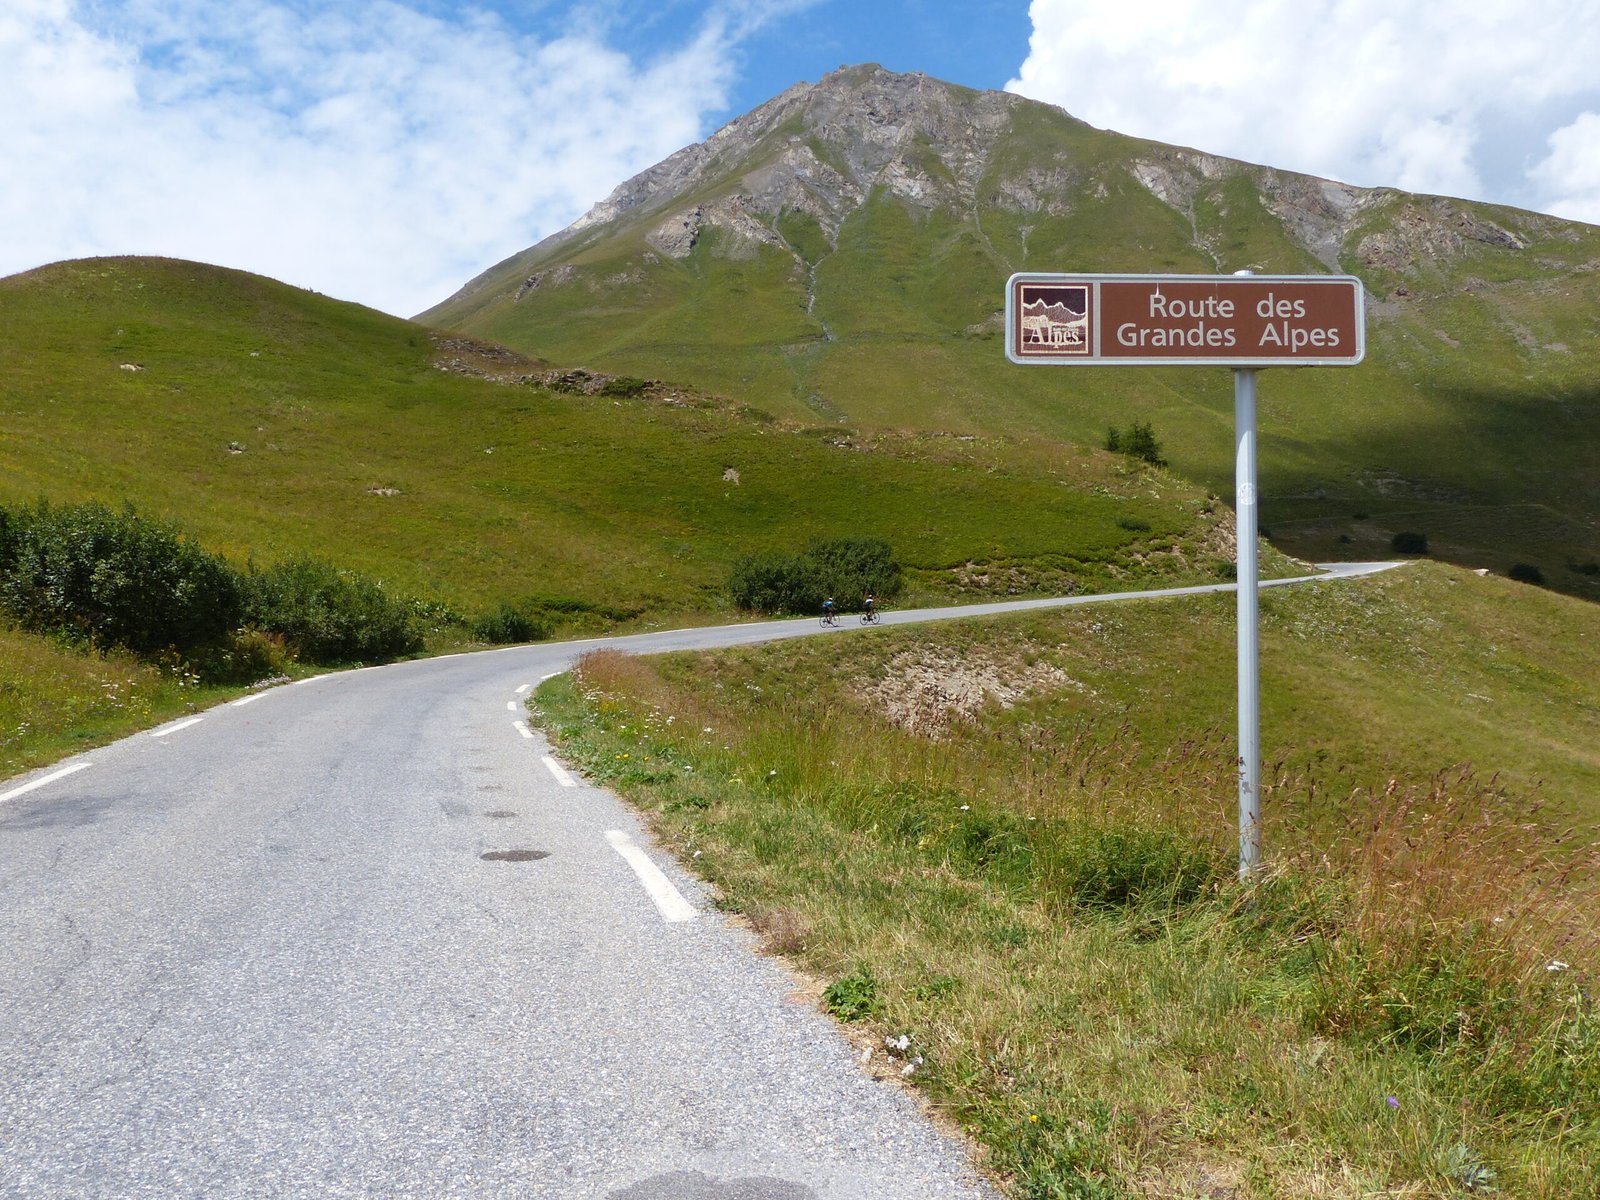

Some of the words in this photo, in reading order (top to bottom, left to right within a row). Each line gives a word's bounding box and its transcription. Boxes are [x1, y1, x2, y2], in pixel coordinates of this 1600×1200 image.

[1149, 294, 1235, 318] Route
[1256, 293, 1306, 318] des
[1028, 324, 1080, 349] Alpes
[1116, 321, 1236, 347] Grandes
[1259, 321, 1340, 353] Alpes
